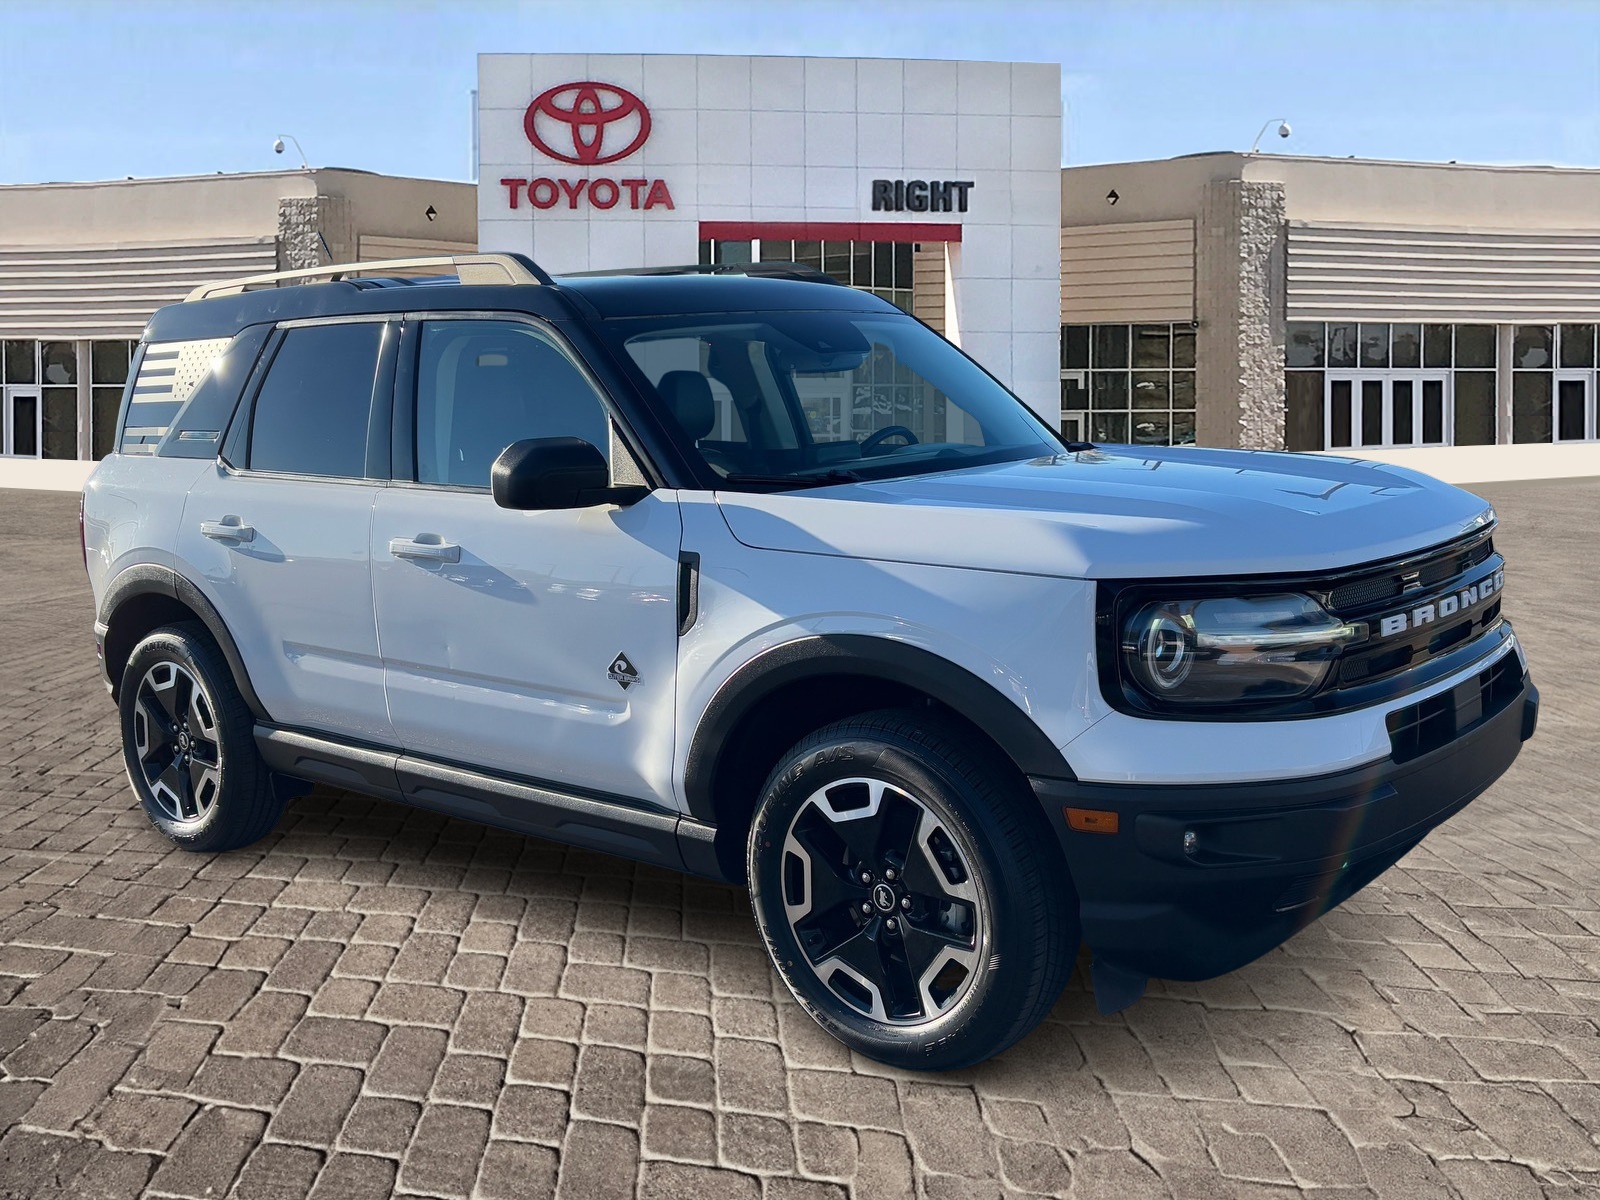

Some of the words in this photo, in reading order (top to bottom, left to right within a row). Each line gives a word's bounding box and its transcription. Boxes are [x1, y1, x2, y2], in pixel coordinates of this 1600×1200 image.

[500, 177, 675, 210] TOYOTA
[871, 179, 975, 212] RIGHT
[1380, 570, 1505, 638] BRONCO
[814, 746, 856, 767] A/S
